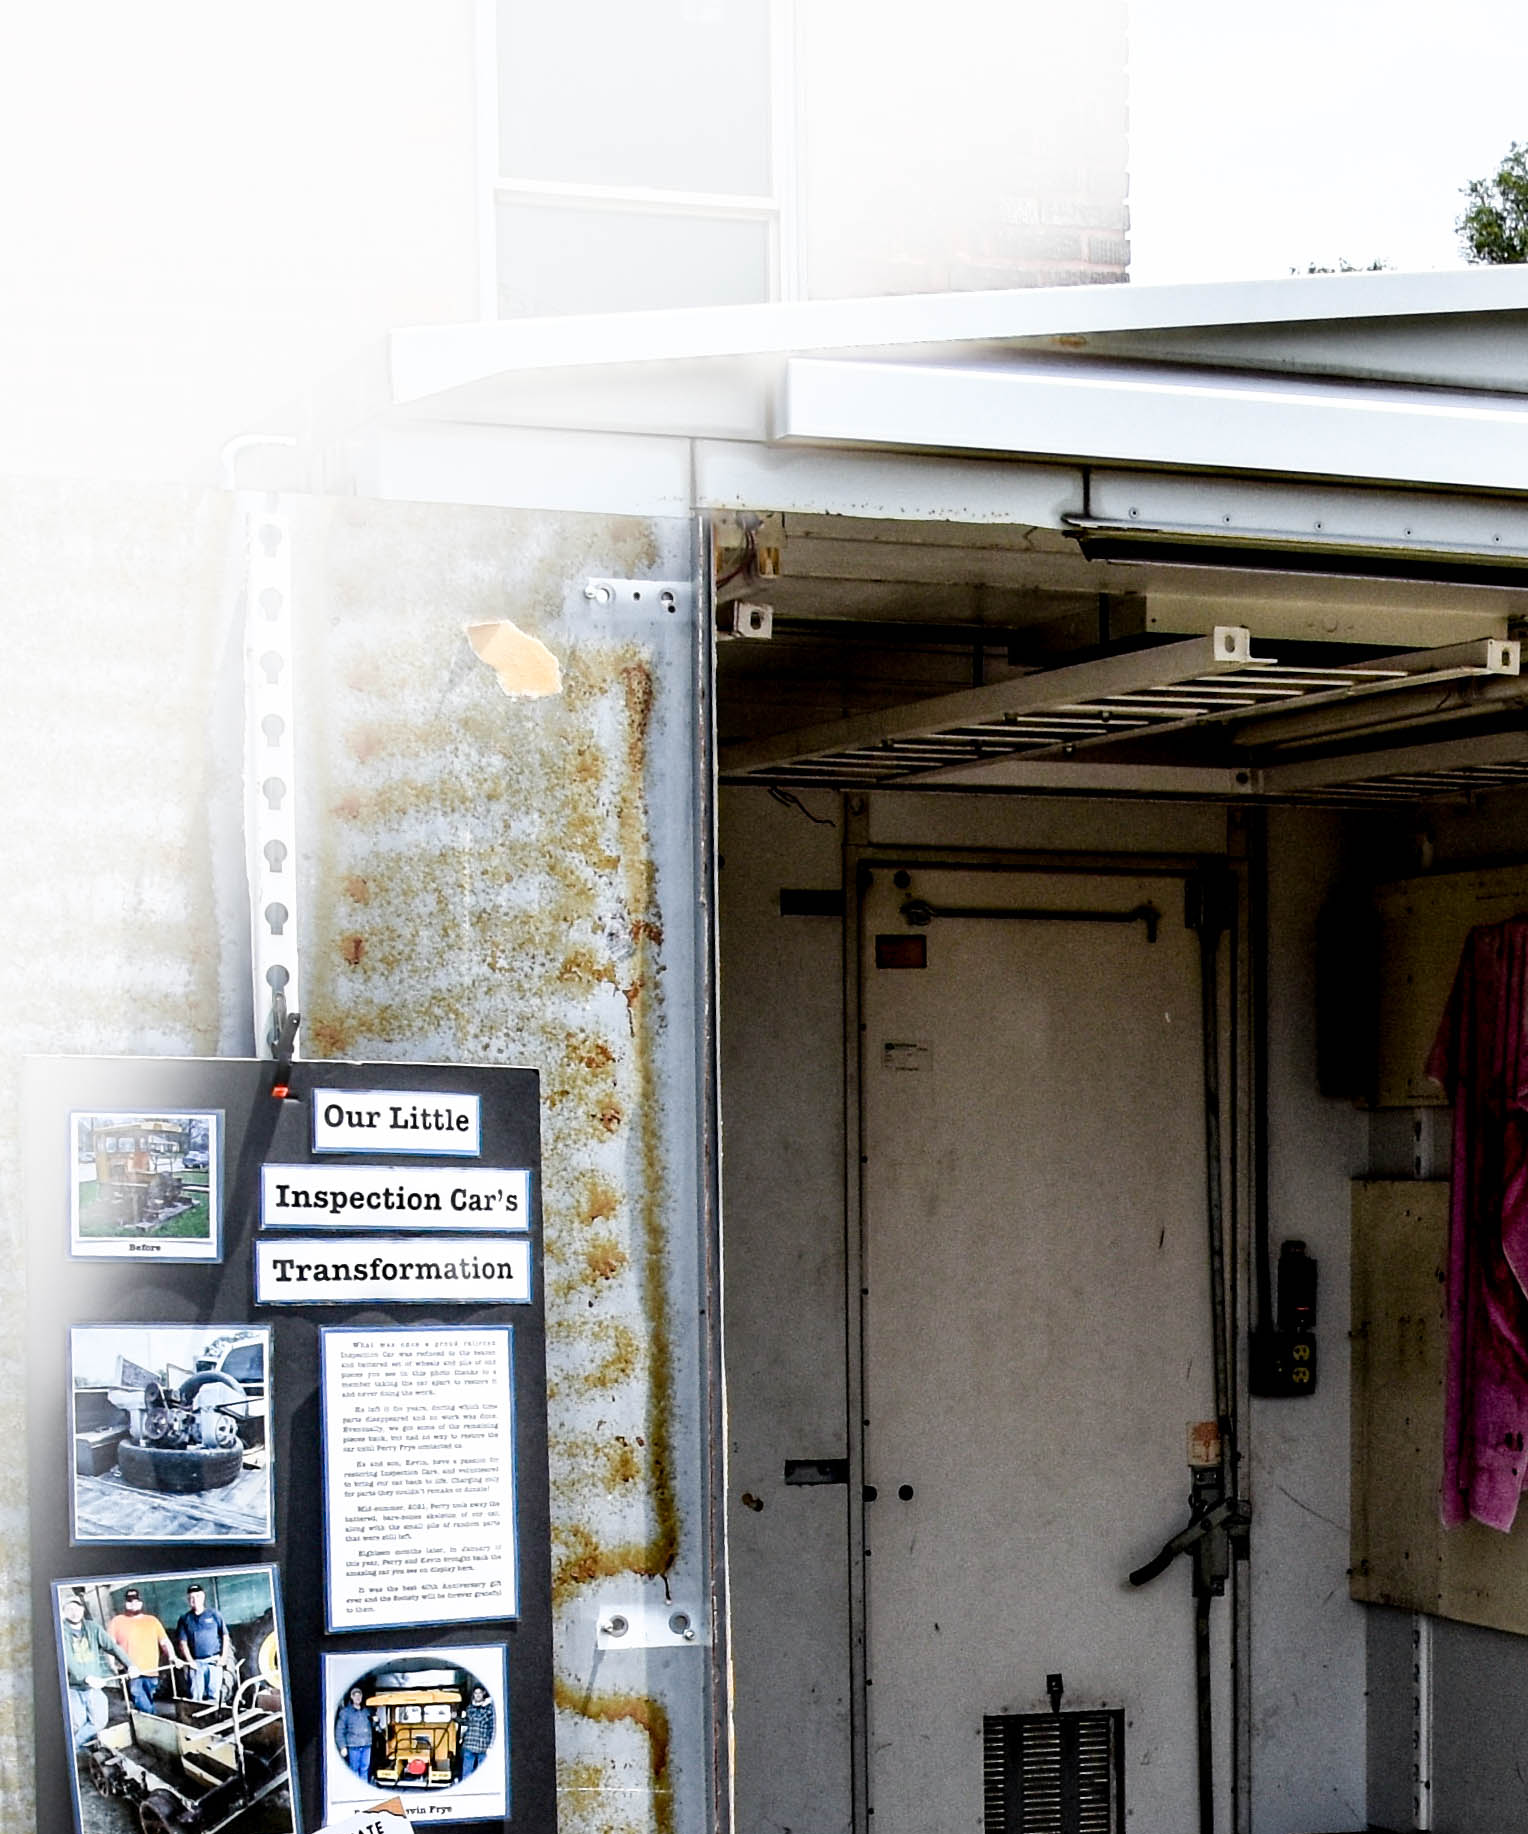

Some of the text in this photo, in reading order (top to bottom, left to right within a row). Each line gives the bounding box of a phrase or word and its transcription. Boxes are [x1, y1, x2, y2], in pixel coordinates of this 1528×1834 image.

[324, 1104, 469, 1131] Our Little
[275, 1184, 518, 1213] Inspection Car's
[129, 1244, 161, 1252] Before
[272, 1257, 513, 1282] Transformation
